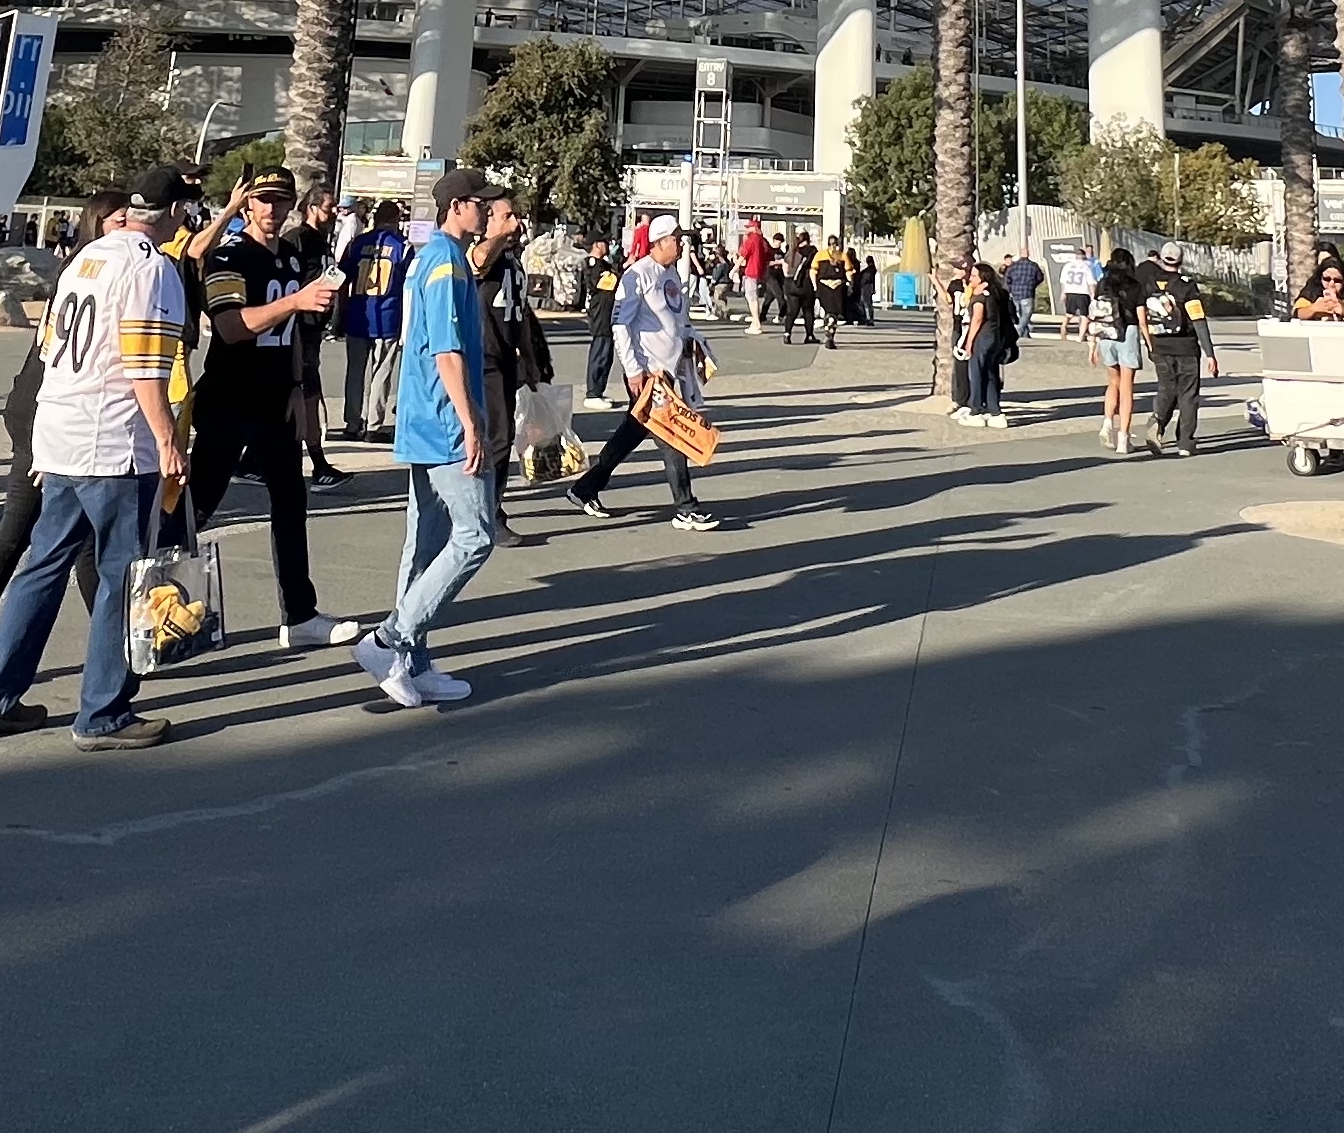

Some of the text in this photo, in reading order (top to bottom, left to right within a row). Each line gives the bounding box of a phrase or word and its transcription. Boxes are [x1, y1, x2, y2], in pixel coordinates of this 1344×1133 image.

[698, 62, 725, 72] ENTRY
[707, 72, 715, 86] 8
[1066, 271, 1084, 285] 33
[51, 292, 96, 373] 90
